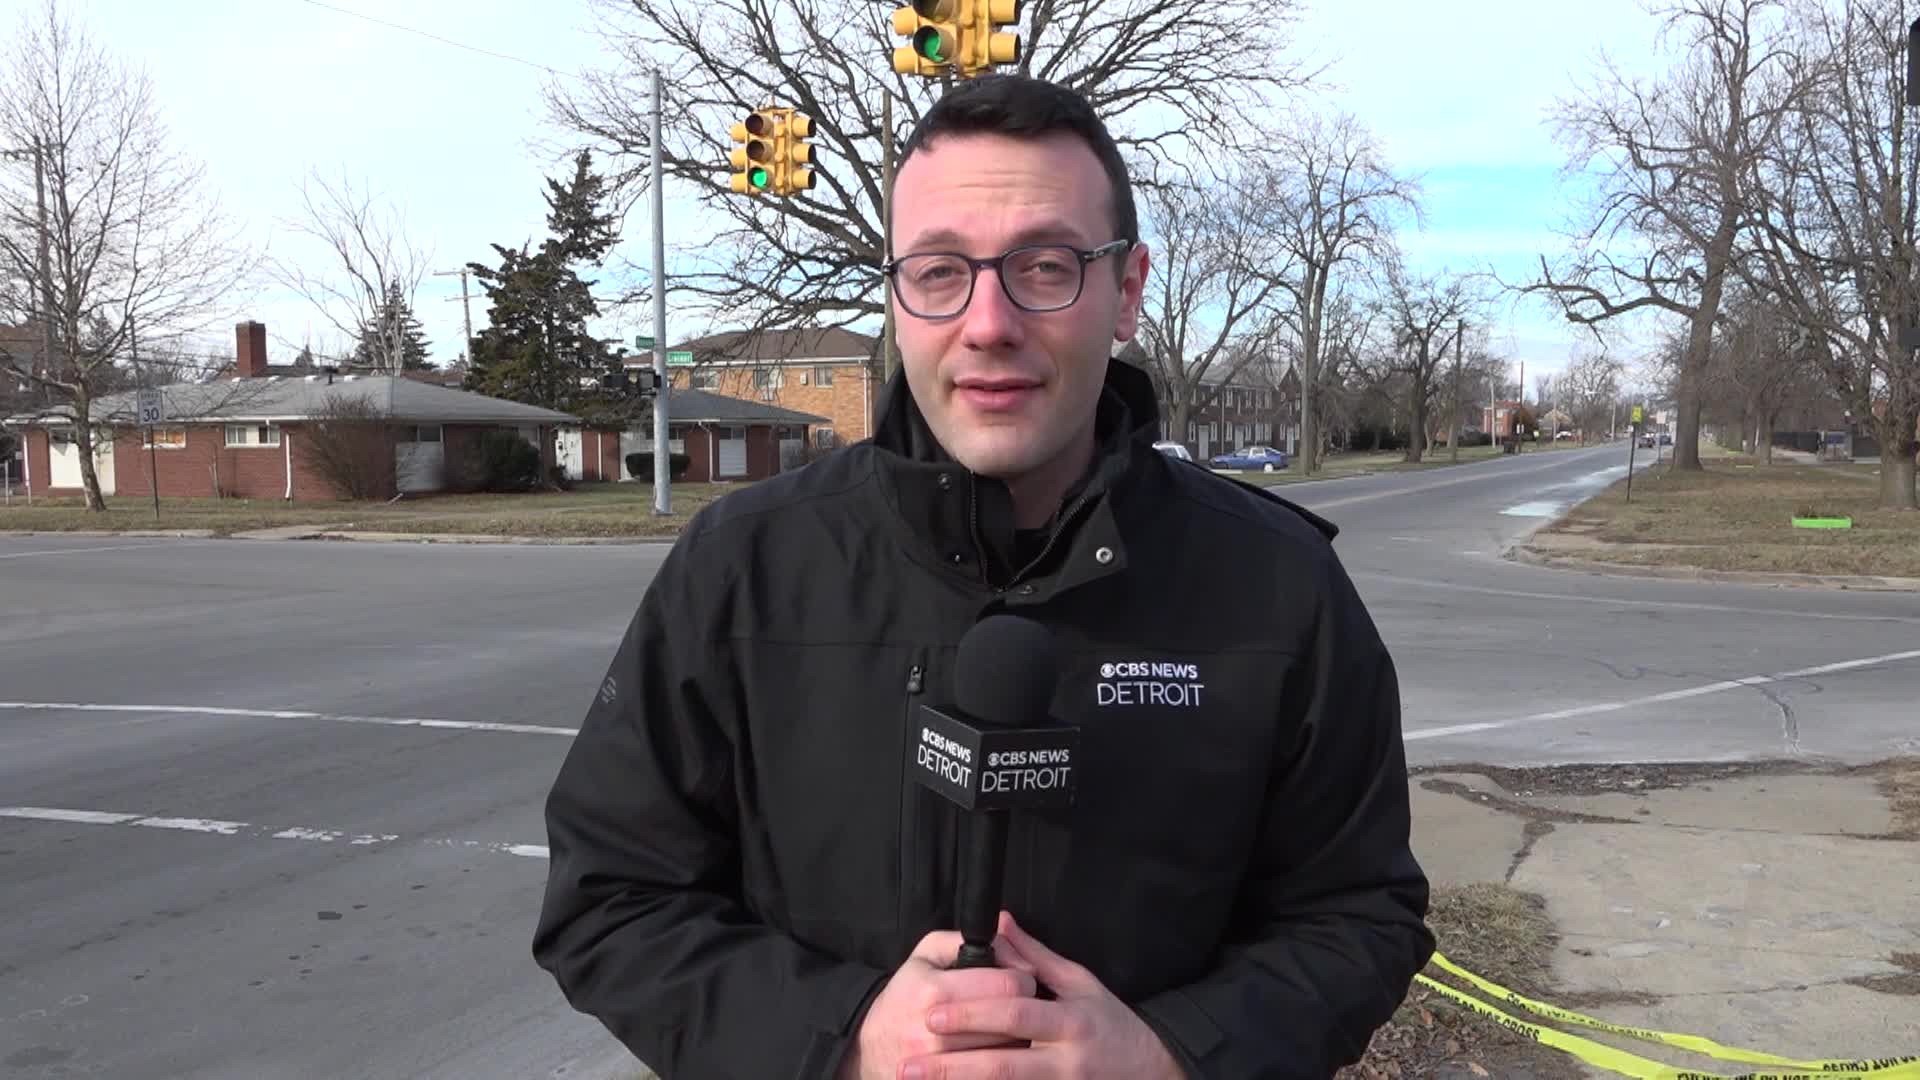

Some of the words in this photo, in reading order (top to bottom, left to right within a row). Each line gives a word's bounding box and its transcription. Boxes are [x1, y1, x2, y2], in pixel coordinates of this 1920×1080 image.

[143, 407, 160, 422] 30
[1115, 661, 1149, 677] CBS
[1151, 662, 1198, 680] NEWS
[1096, 681, 1205, 706] DETROIT
[929, 731, 945, 751] CBS
[945, 739, 972, 763] NEWS
[1000, 751, 1028, 767] CBS
[1028, 749, 1070, 764] NEWS
[917, 743, 972, 789] DETROIT
[981, 767, 1072, 793] DETROIT
